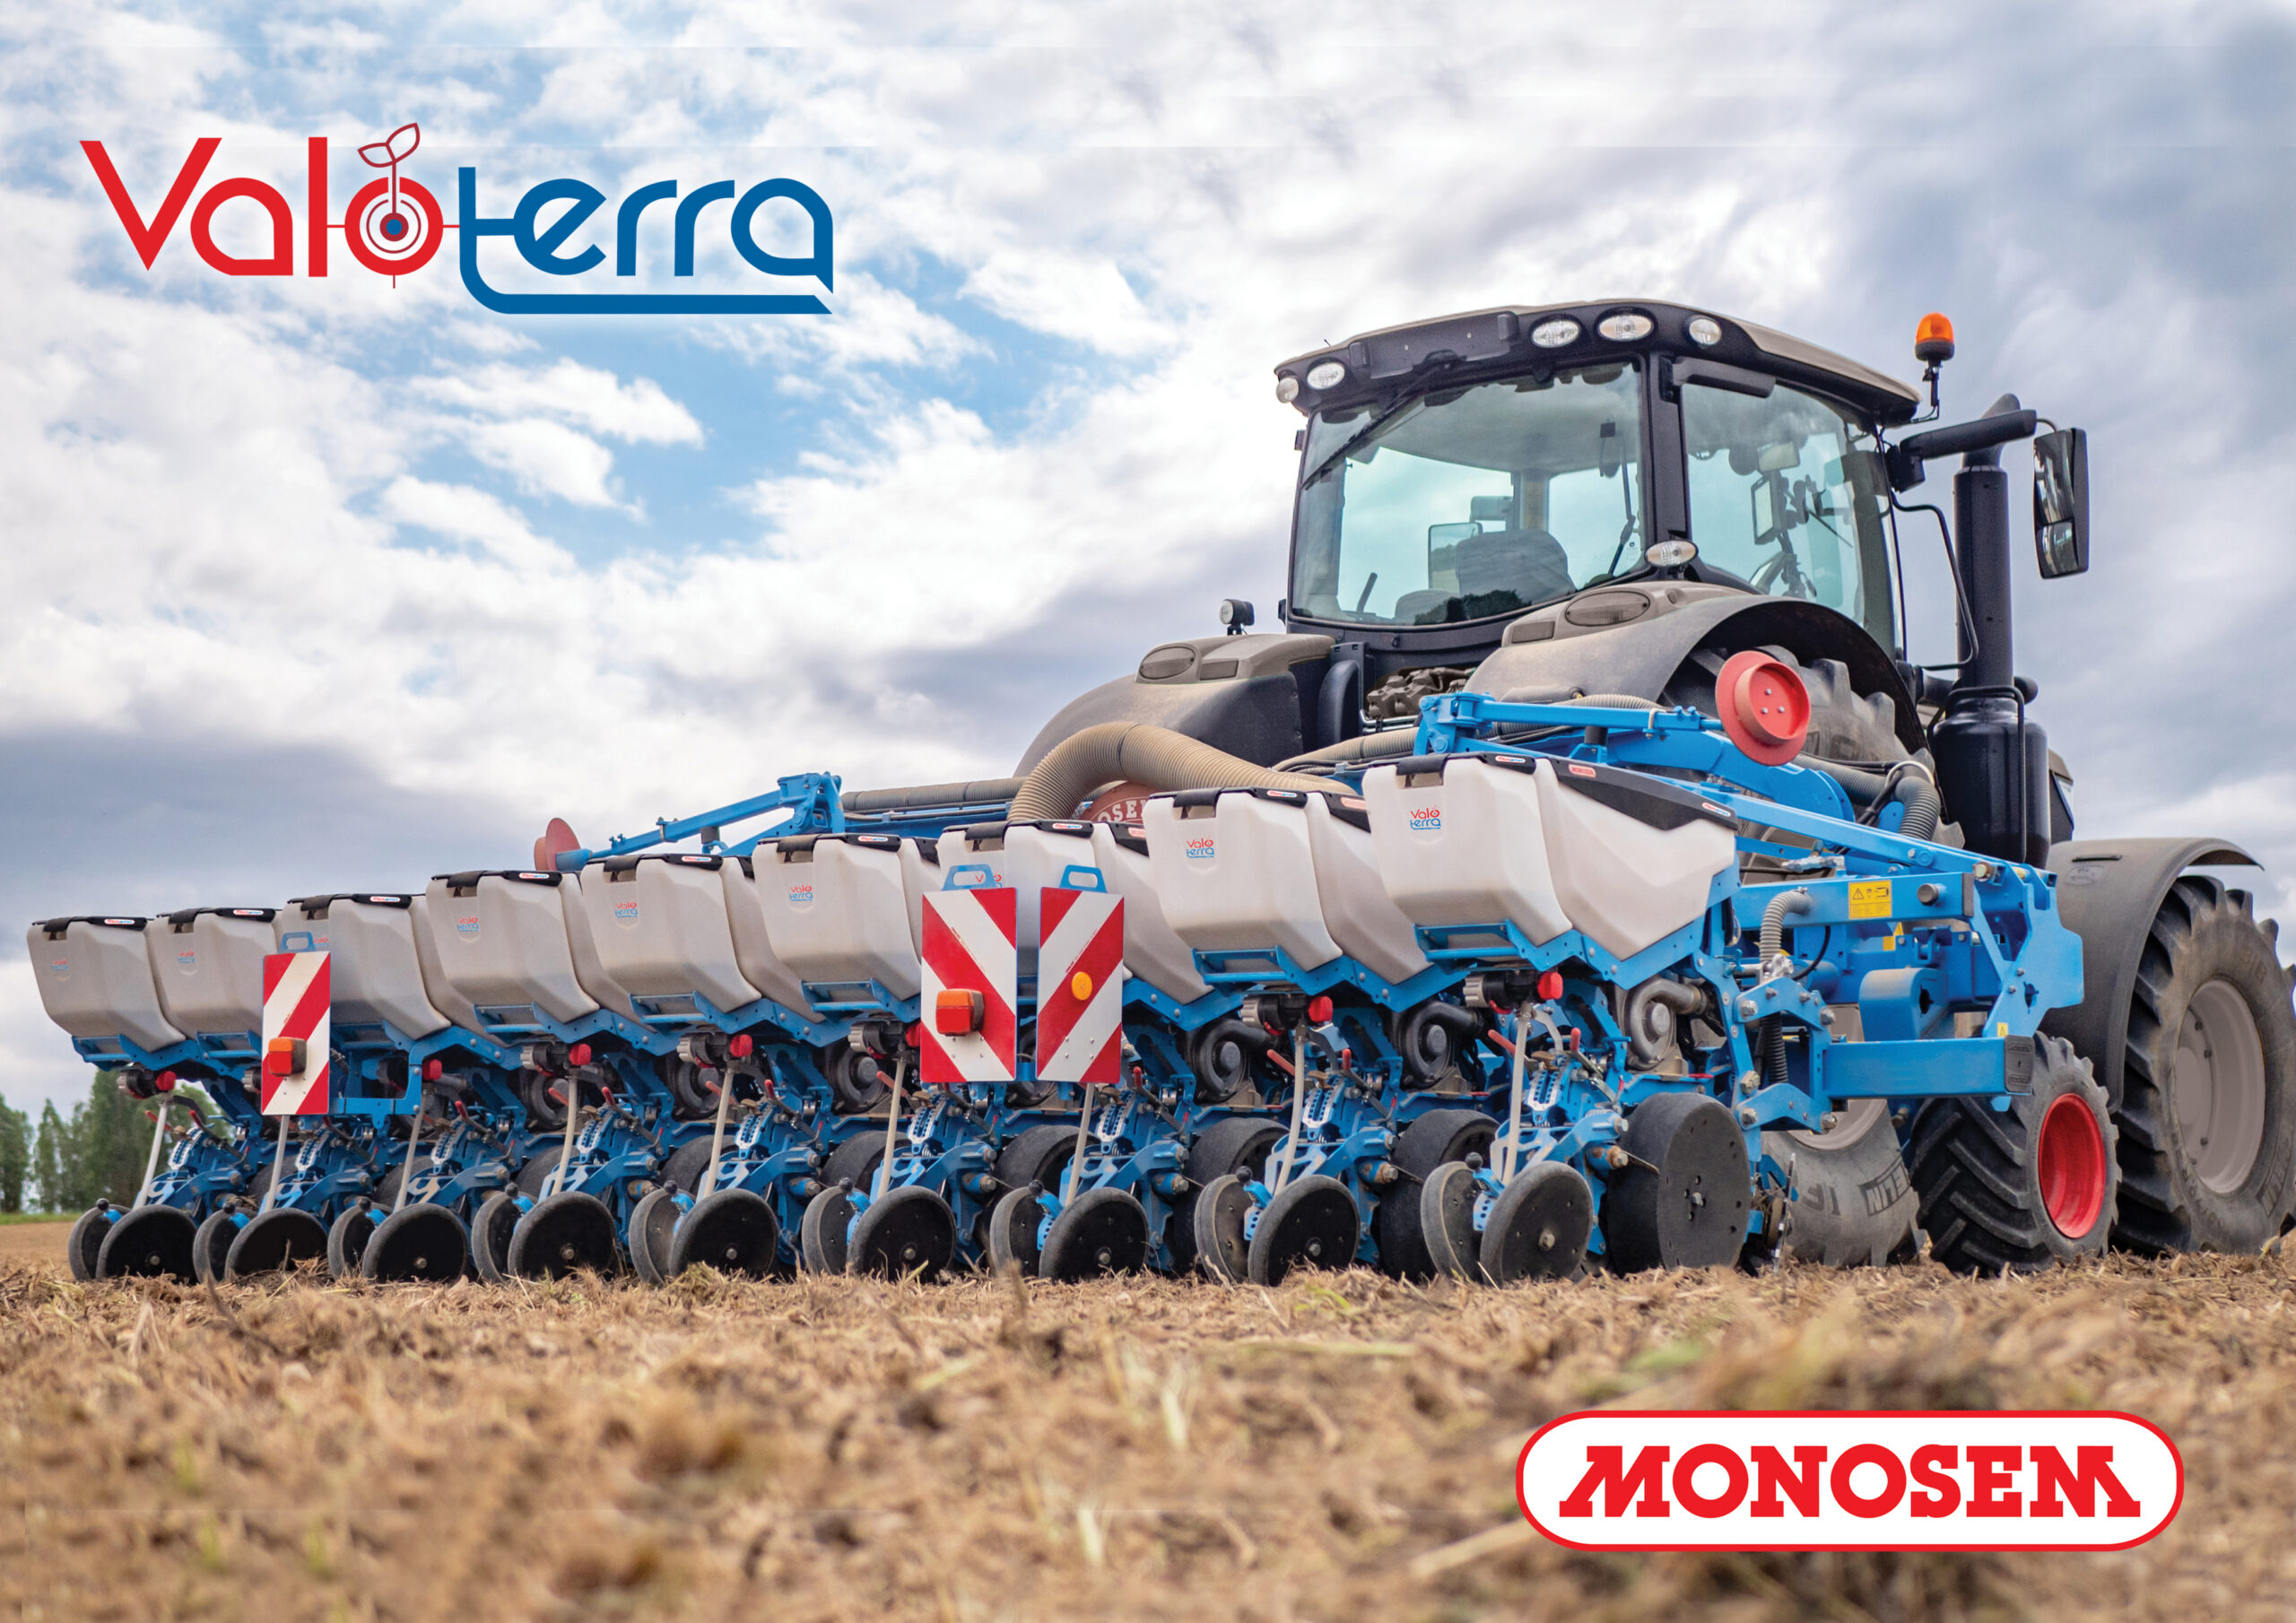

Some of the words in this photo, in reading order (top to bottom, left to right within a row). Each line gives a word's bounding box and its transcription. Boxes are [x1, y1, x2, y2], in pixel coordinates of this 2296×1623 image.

[1097, 799, 1147, 822] OSE
[1410, 806, 1440, 819] Valo
[1410, 818, 1440, 830] terra
[1187, 837, 1213, 848] Valo
[1187, 847, 1214, 858] terra
[789, 892, 813, 901] terra
